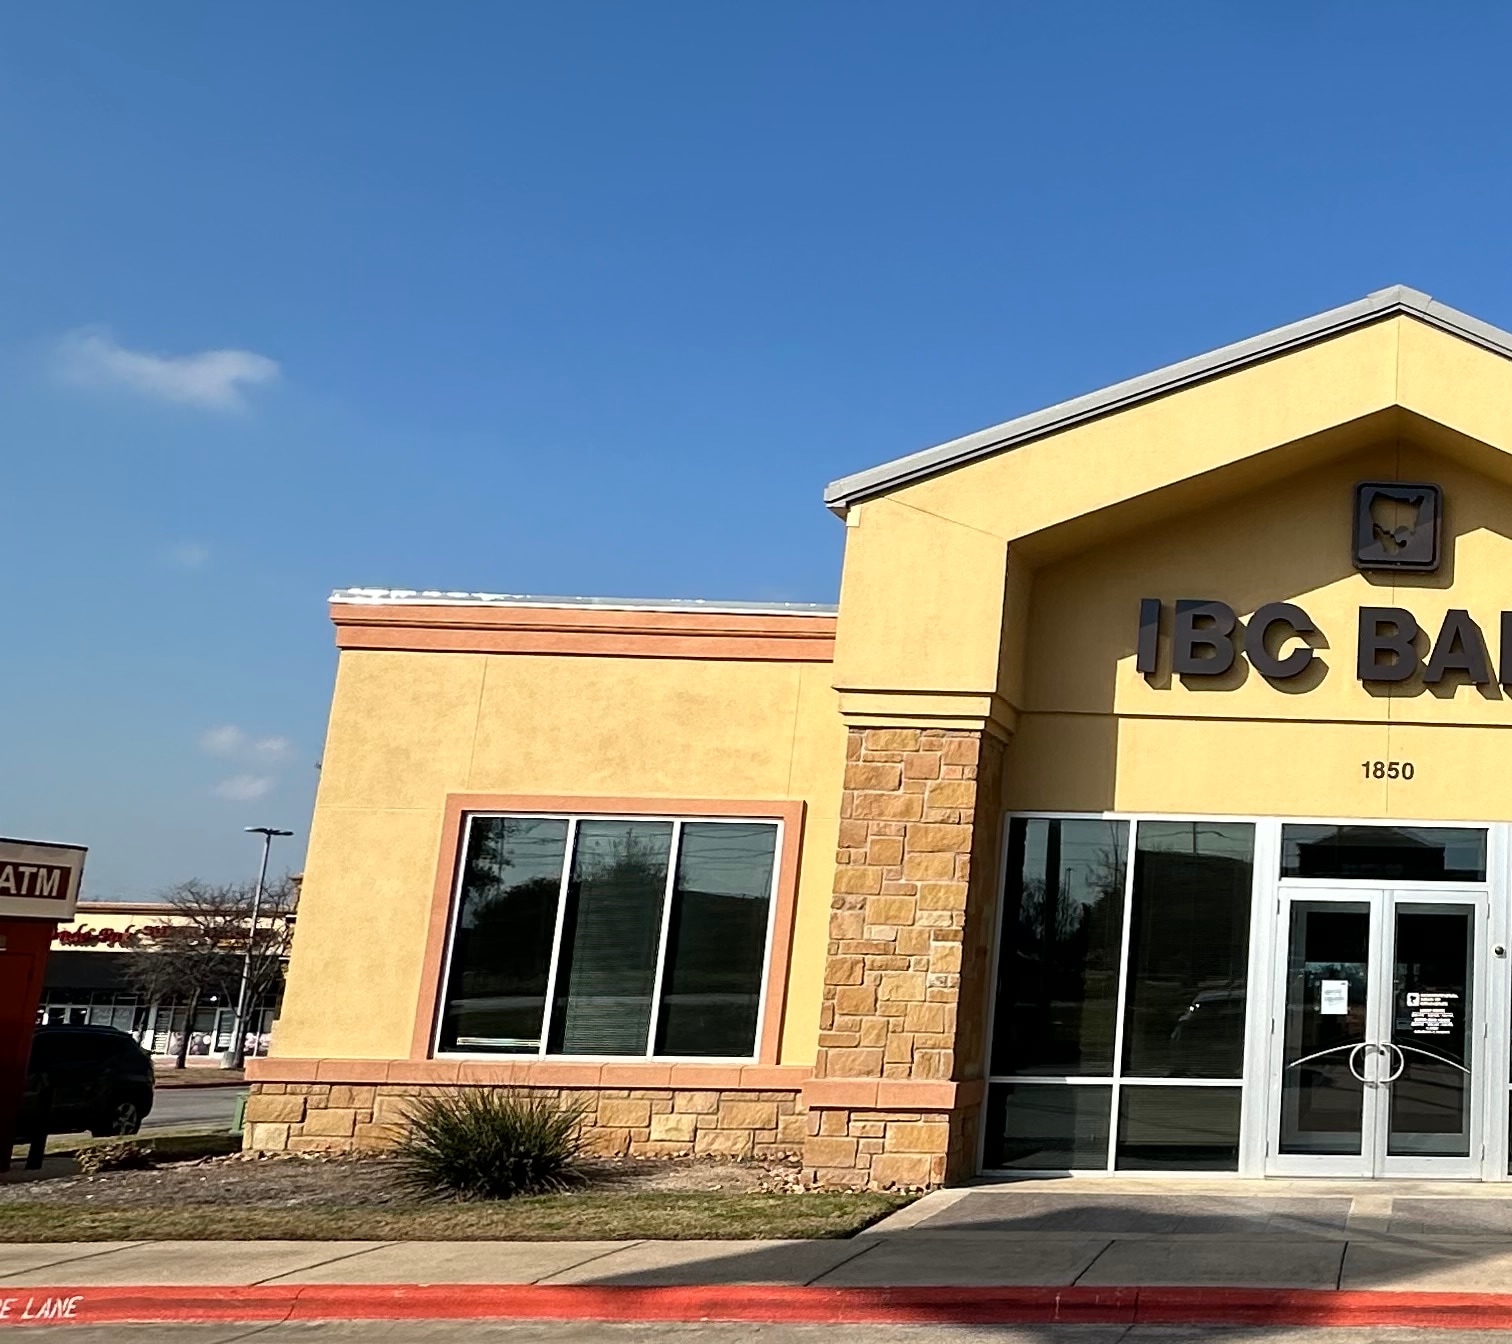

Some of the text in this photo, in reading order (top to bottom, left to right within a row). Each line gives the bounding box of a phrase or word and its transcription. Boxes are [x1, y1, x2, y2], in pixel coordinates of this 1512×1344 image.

[1136, 598, 1315, 678] IBC
[1361, 760, 1415, 780] 1850
[0, 864, 62, 897] ATM
[20, 1295, 84, 1320] LANE
